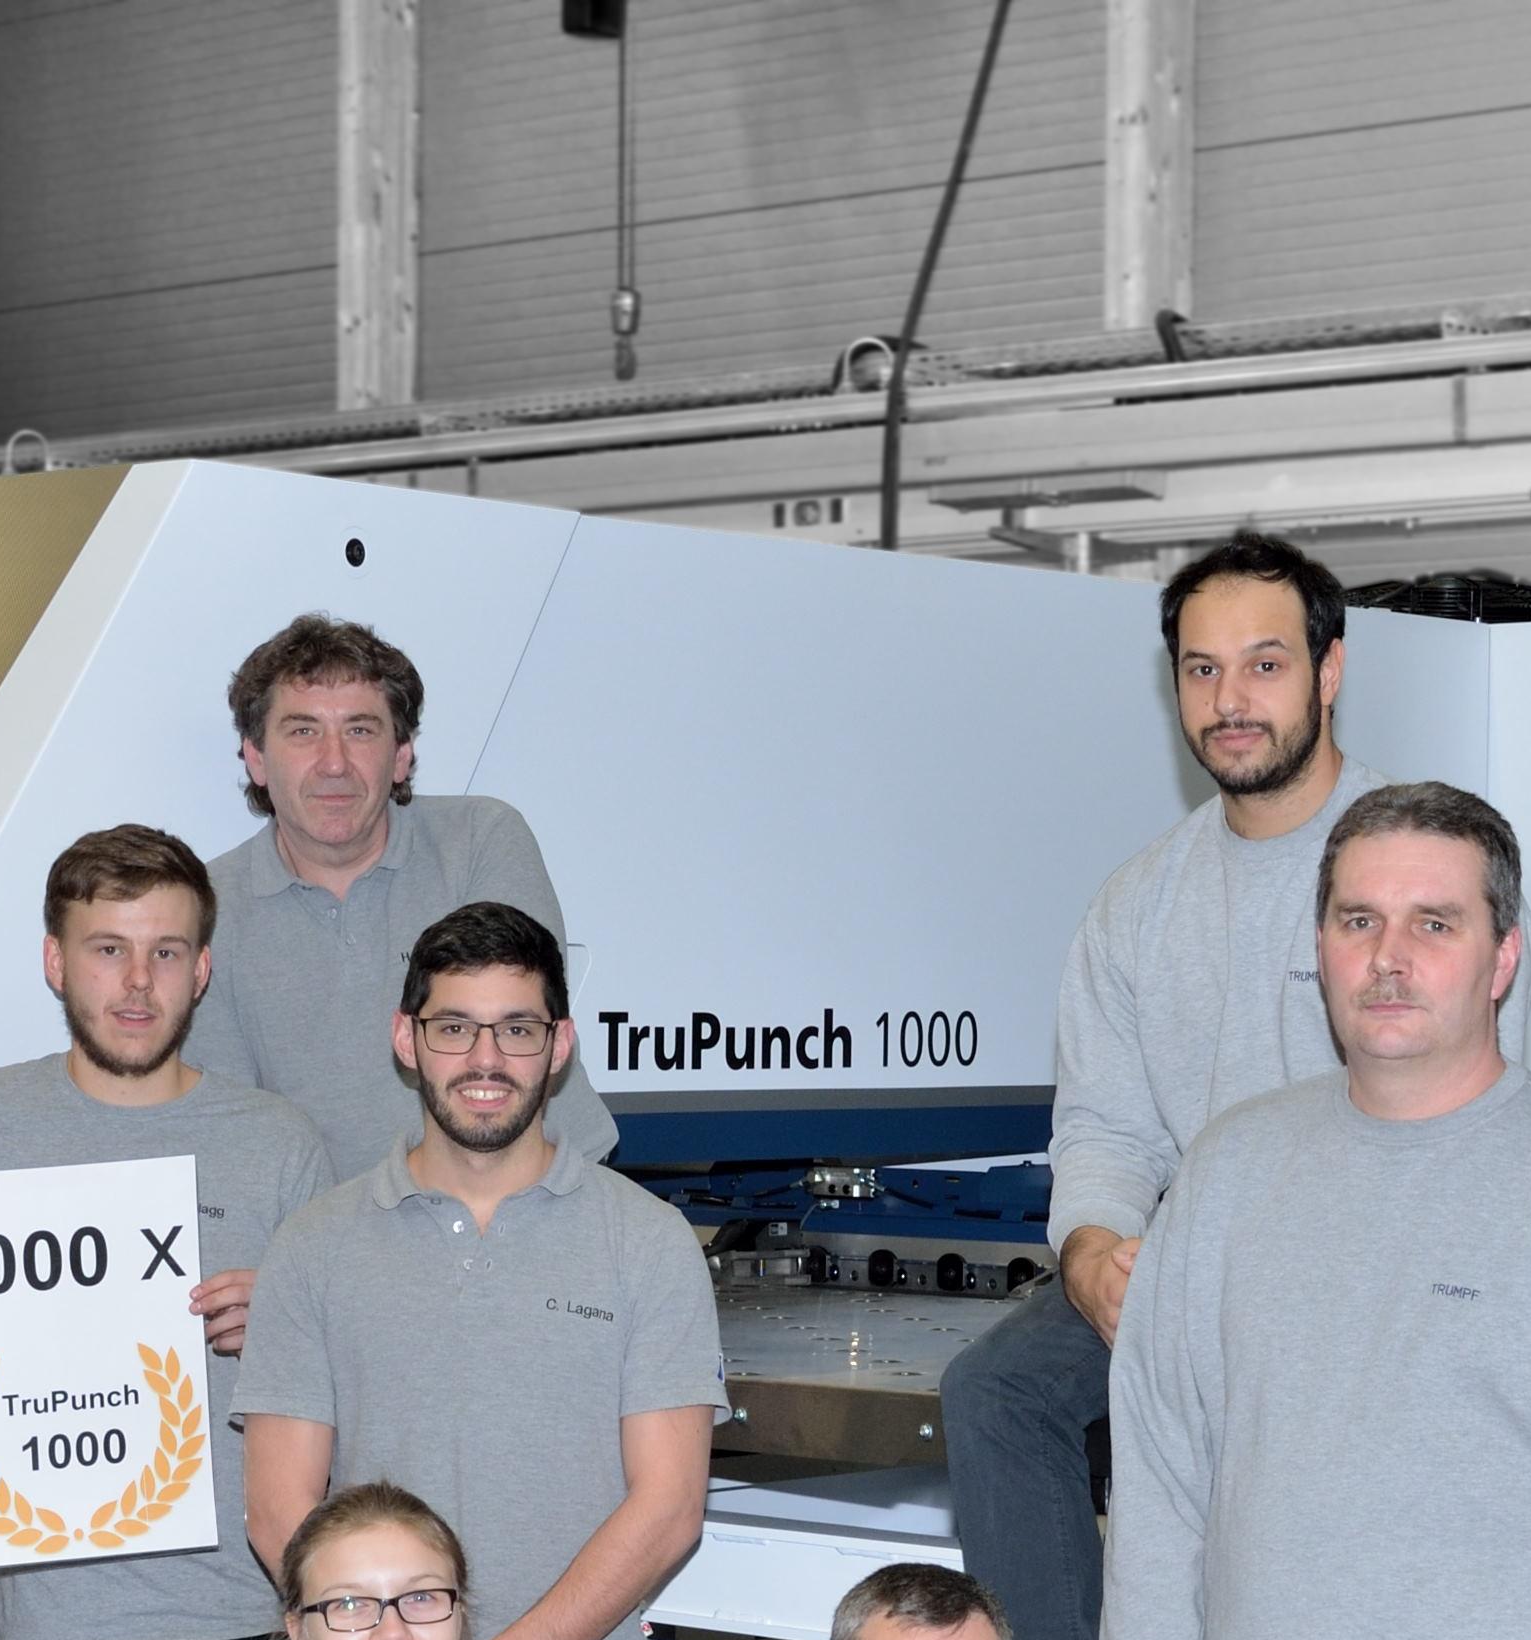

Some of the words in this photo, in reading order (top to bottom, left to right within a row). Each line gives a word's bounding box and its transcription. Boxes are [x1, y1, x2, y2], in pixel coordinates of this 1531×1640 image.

[599, 1009, 853, 1071] TruPunch
[875, 1010, 978, 1068] 1000
[140, 1224, 187, 1281] X
[546, 1297, 560, 1312] C.
[567, 1299, 614, 1322] Lagana
[1431, 1283, 1481, 1302] TRUMPF
[2, 1384, 140, 1417] TruPunch
[21, 1428, 127, 1471] 1000
